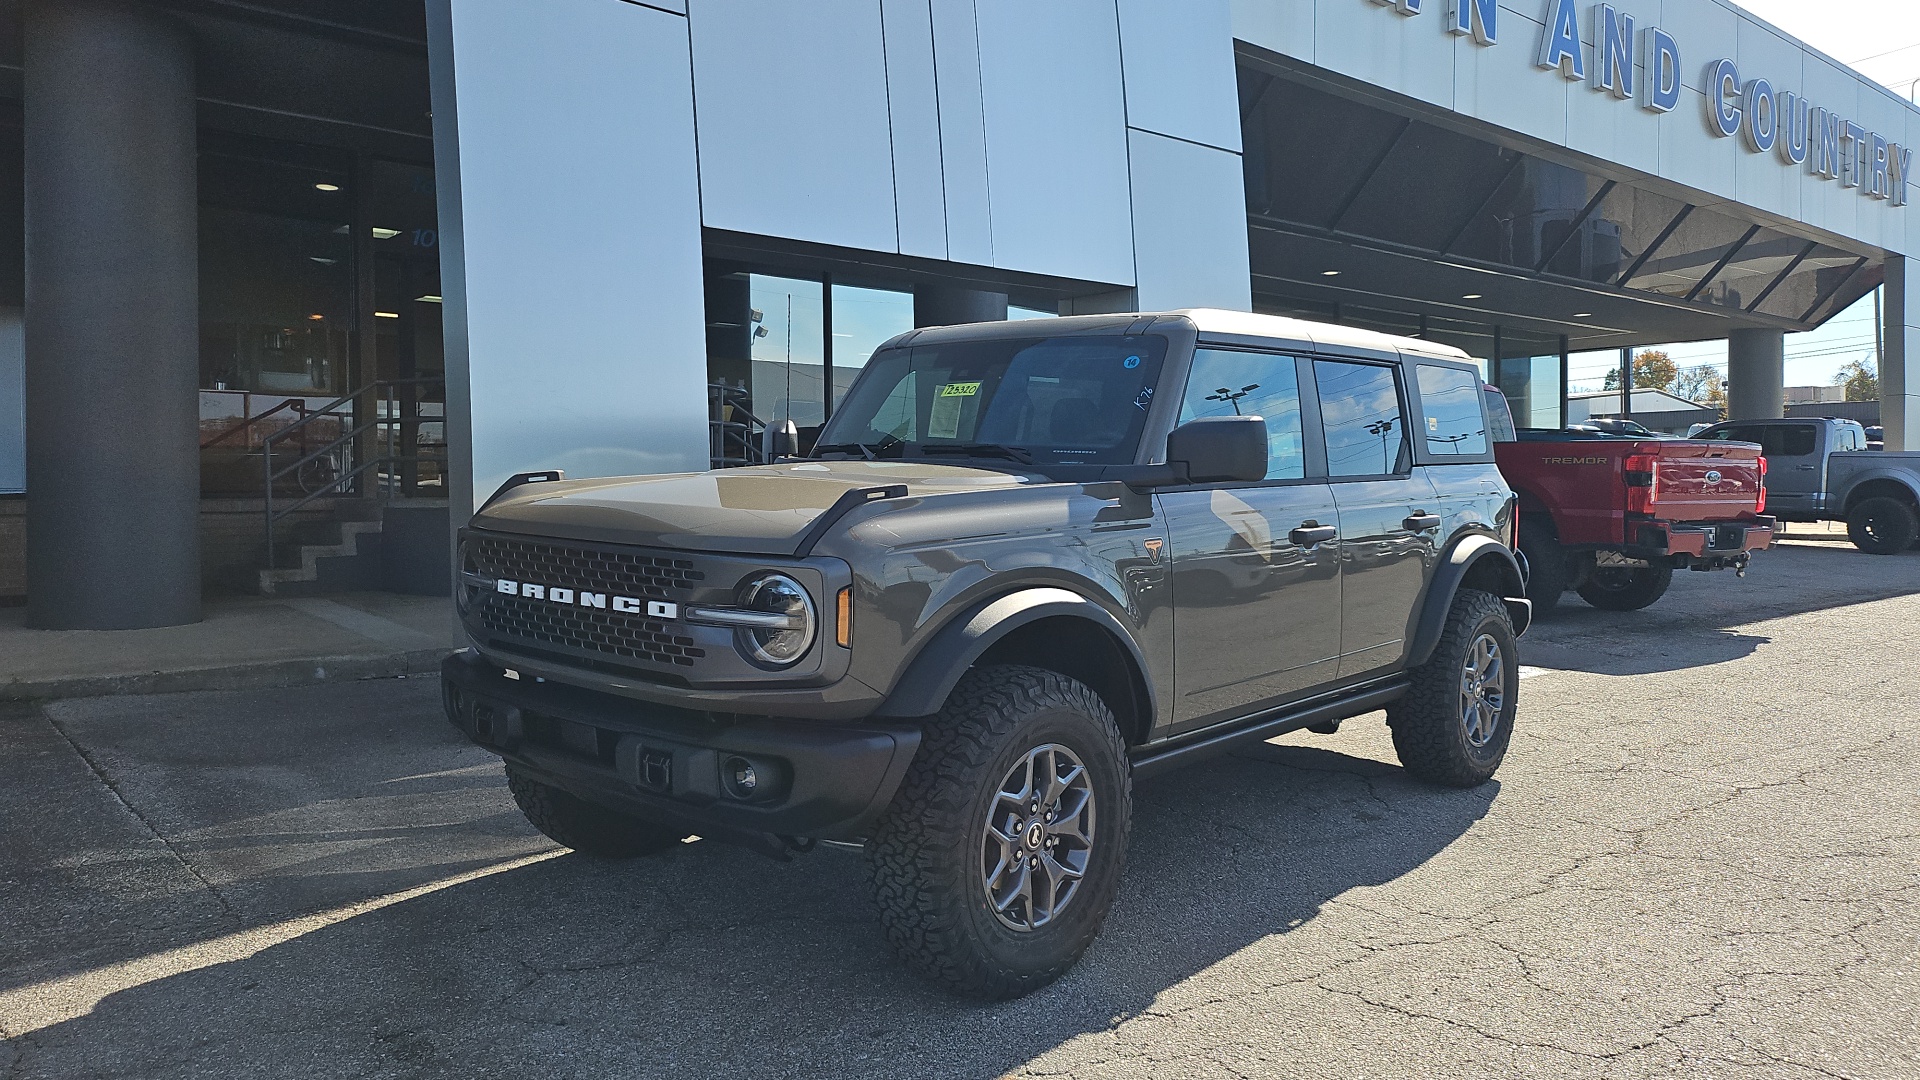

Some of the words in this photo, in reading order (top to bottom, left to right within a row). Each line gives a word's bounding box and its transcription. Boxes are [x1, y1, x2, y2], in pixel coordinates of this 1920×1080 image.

[1538, 0, 1682, 113] AND
[1706, 57, 1913, 206] COUNTRY
[945, 384, 977, 395] T25320
[497, 578, 677, 619] BRONCO
